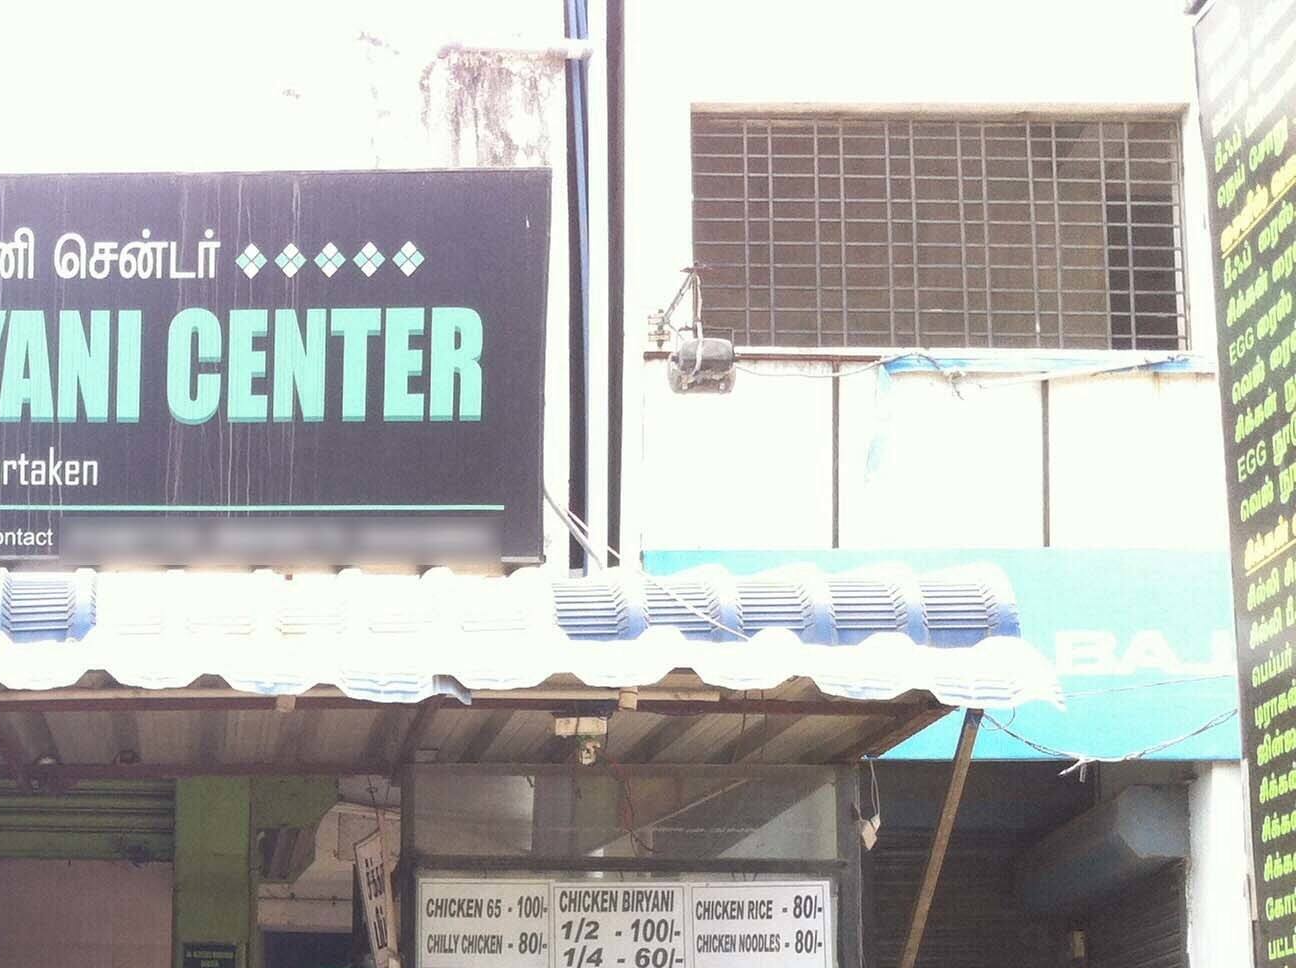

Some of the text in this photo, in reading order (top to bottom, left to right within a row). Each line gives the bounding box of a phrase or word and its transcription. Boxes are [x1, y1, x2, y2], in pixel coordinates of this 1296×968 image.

[54, 228, 222, 280] சென்டர்
[1229, 326, 1255, 366] EGG
[166, 306, 484, 426] CENTER
[1237, 440, 1267, 482] EGG
[426, 898, 483, 919] CHICKEN
[486, 898, 502, 918] 65
[517, 894, 549, 919] 100/-
[559, 889, 675, 913] CHICKEN BIRYANI
[696, 900, 745, 920] CHICKEN
[748, 899, 774, 920] RICE
[792, 895, 823, 919] 80/-
[560, 920, 600, 943] 1/2
[631, 919, 681, 943] 100/-
[696, 934, 735, 953] CHICKEN
[738, 934, 781, 953] NOODLES
[794, 931, 823, 954] 80/-
[427, 935, 459, 955] CHILLY
[461, 935, 502, 954] CHICKEN
[518, 932, 548, 956] 80/-
